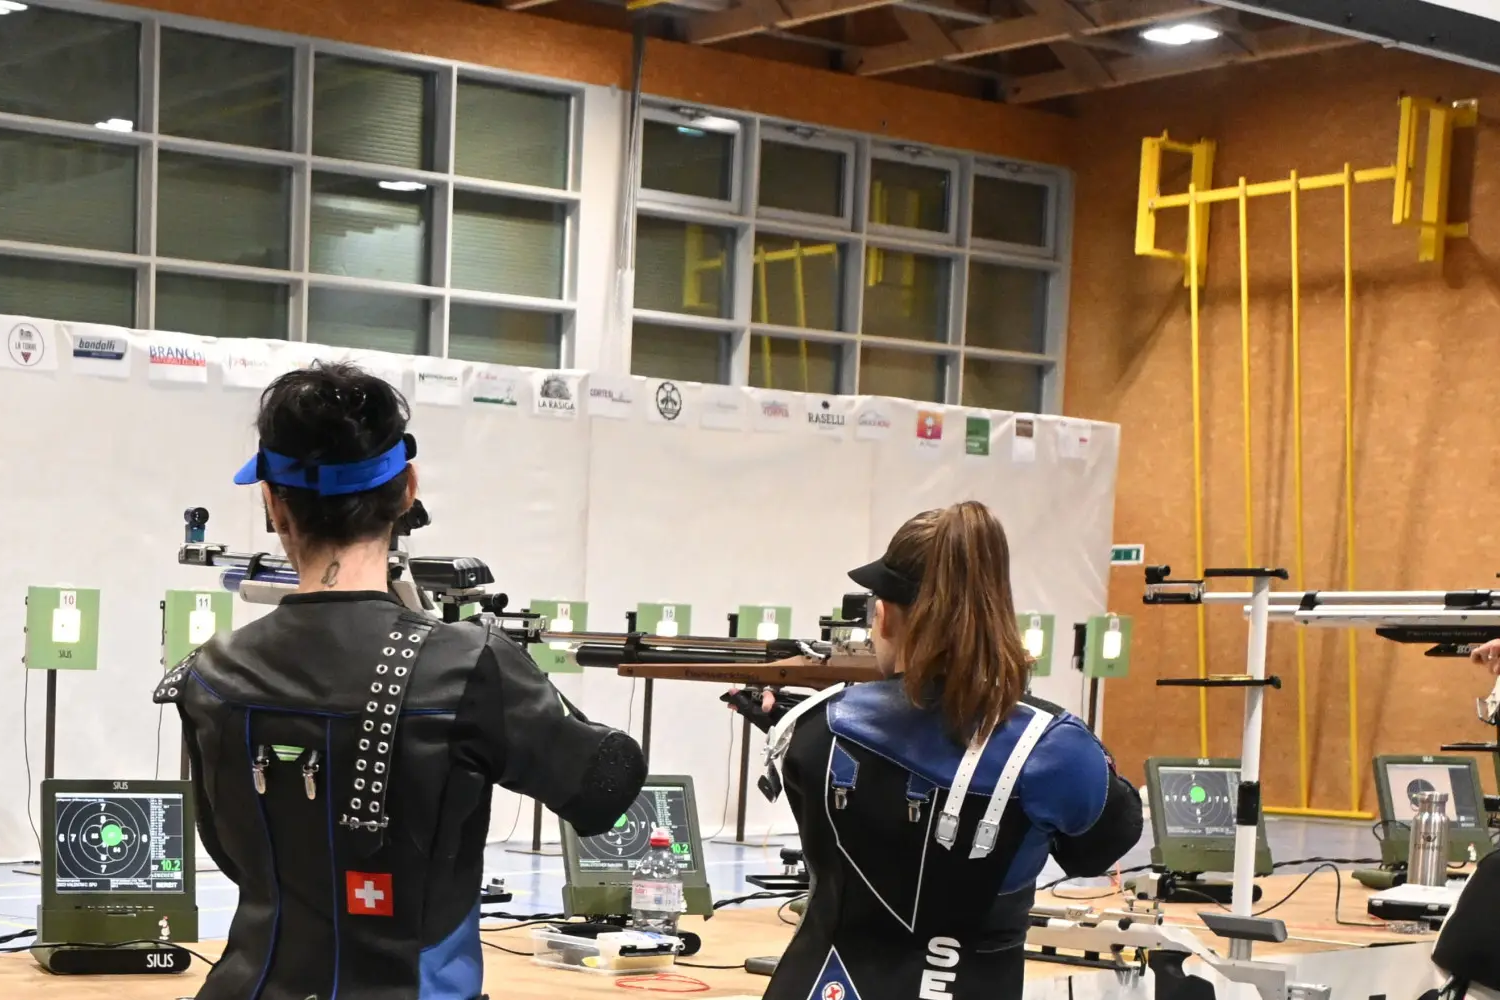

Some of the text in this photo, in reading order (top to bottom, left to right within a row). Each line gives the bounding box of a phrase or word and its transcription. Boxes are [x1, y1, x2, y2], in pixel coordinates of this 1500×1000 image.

[807, 412, 845, 426] RASELLI
[62, 595, 75, 606] 10
[198, 597, 209, 607] 11
[112, 781, 129, 790] SIUS
[100, 803, 106, 812] 7
[640, 821, 646, 829] 7
[70, 833, 76, 842] 7
[617, 847, 623, 855] 7
[670, 843, 690, 854] 10.2
[100, 864, 107, 873] 7
[160, 859, 181, 871] 10.2
[146, 953, 174, 968] SIUS
